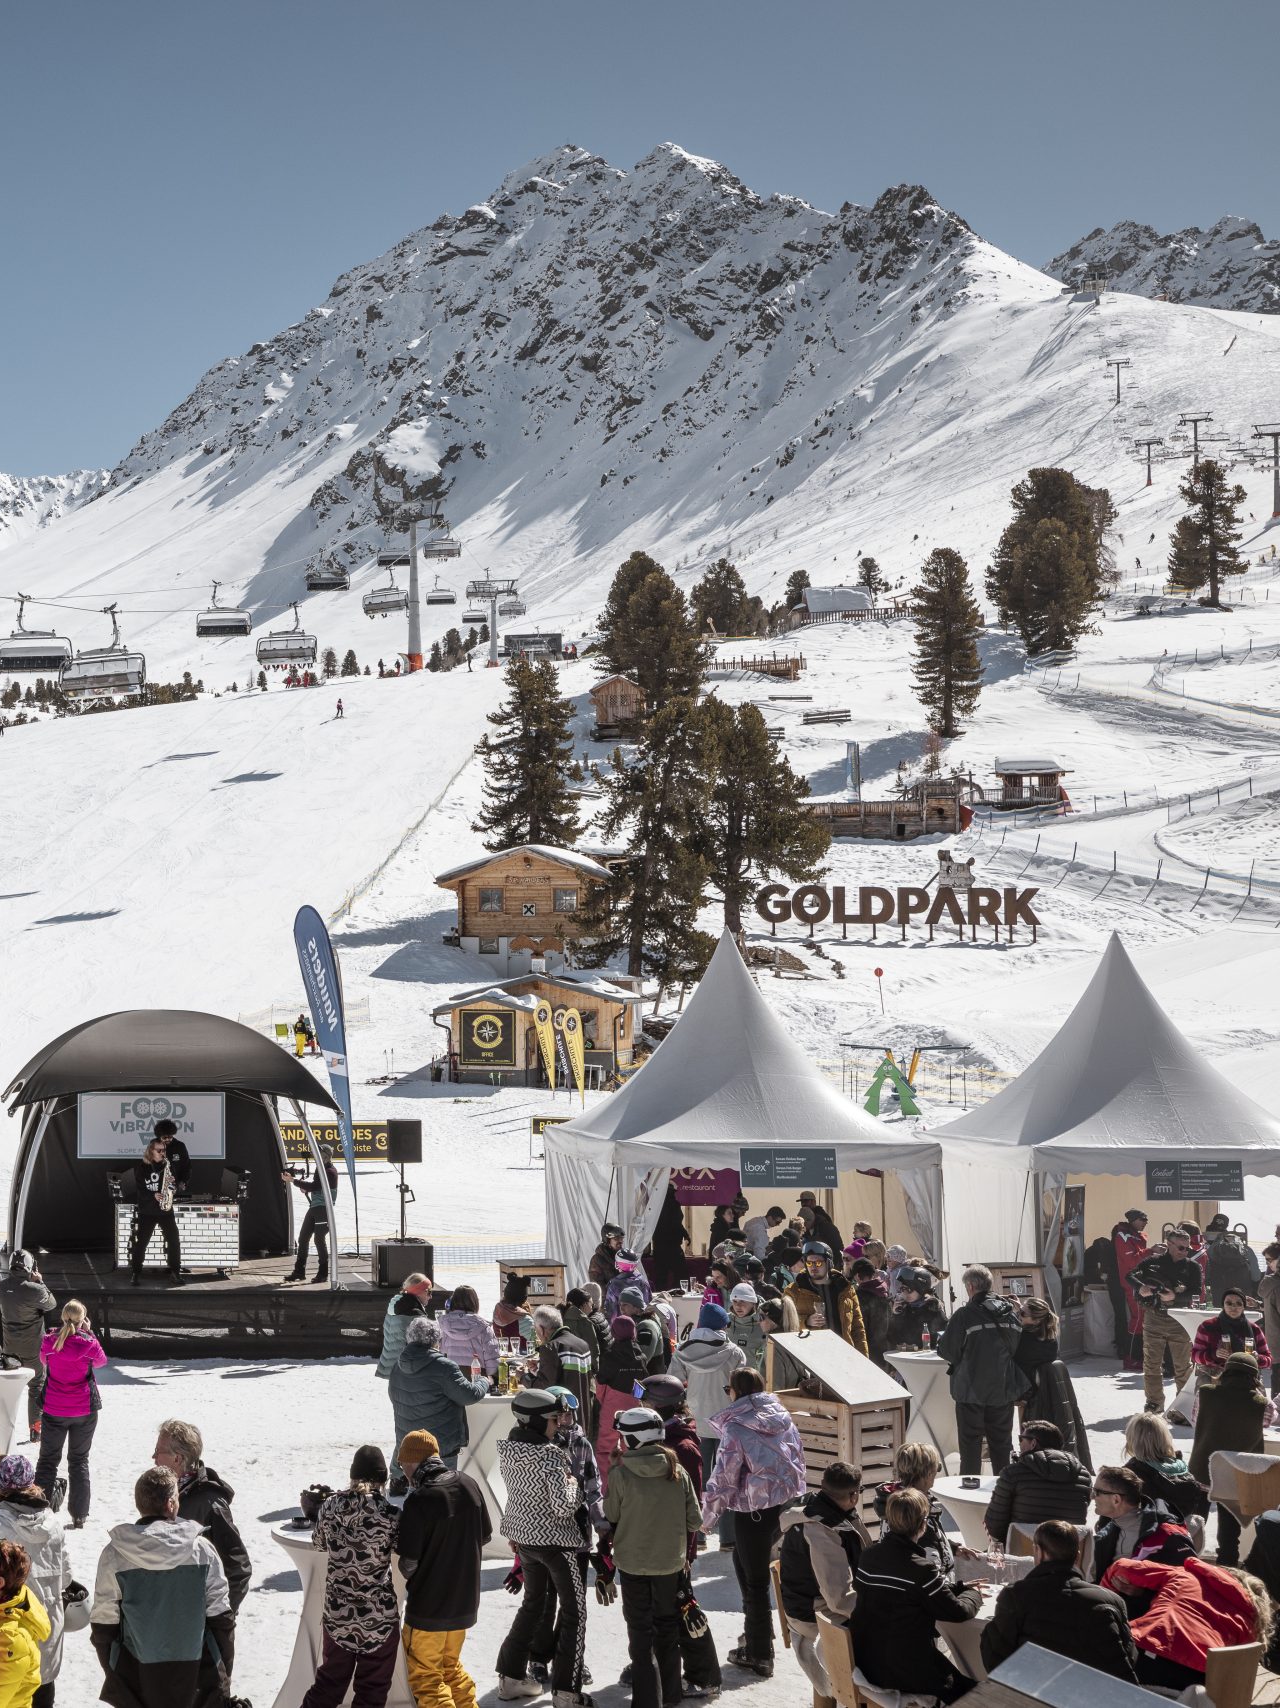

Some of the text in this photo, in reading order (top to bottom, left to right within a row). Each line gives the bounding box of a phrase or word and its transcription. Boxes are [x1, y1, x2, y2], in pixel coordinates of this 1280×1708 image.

[756, 884, 1041, 925] GOLDPARK
[120, 1097, 187, 1119] FOOD
[744, 1161, 767, 1172] ibex
